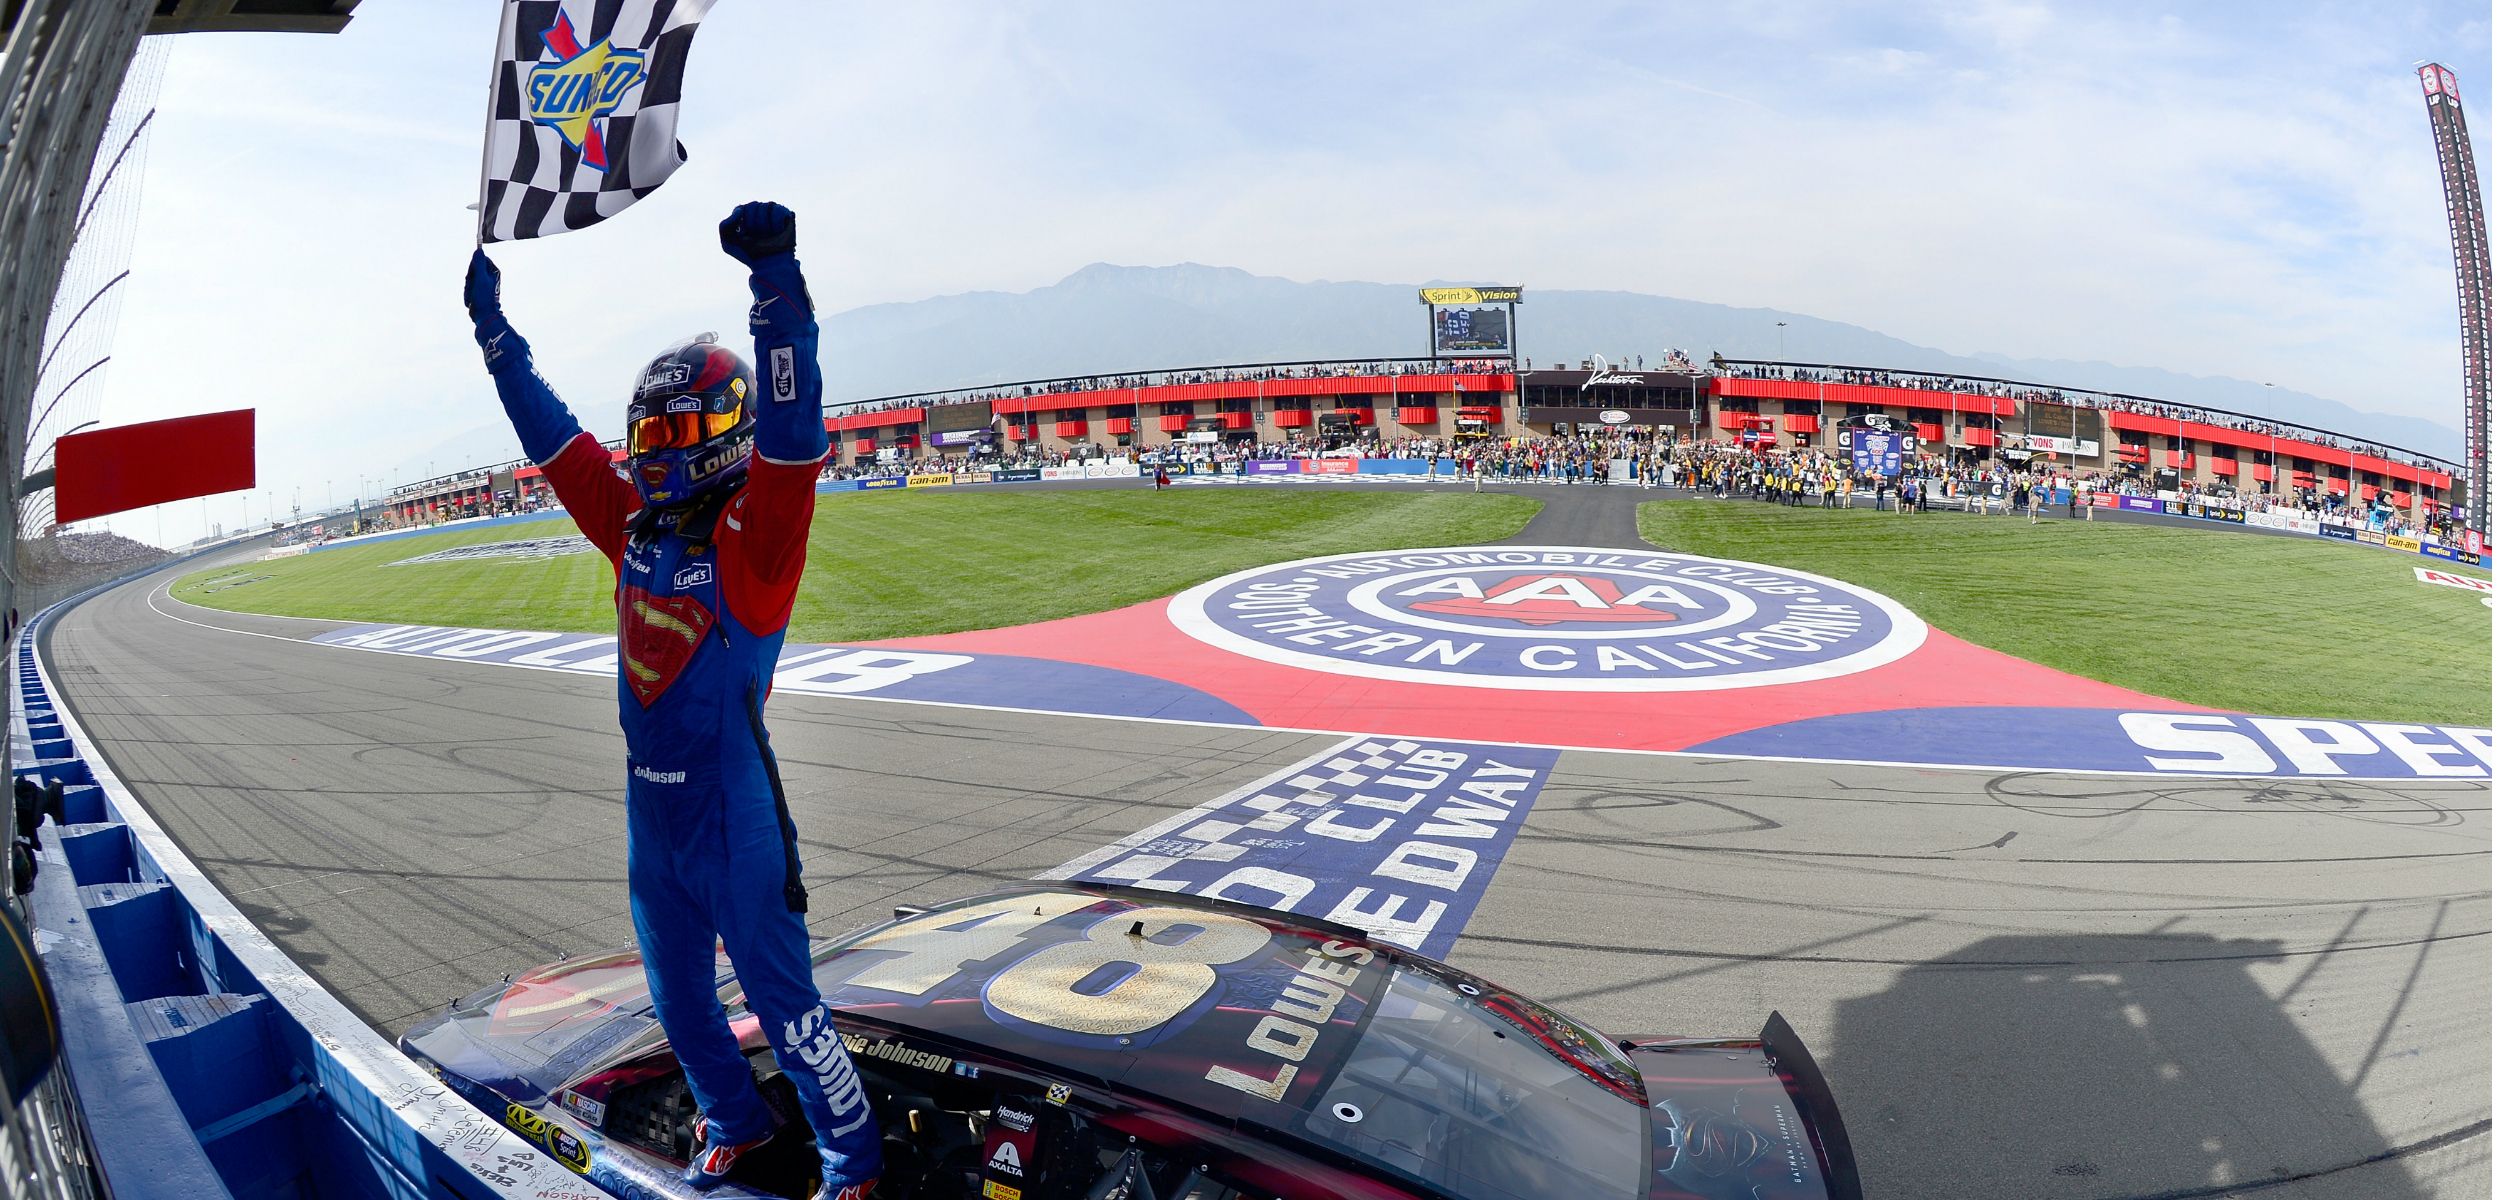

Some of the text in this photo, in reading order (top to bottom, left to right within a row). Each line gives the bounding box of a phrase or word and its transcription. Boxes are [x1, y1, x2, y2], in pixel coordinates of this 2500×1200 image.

[530, 53, 643, 113] SUNCO
[1432, 291, 1517, 301] Sprint Vision
[671, 401, 697, 409] LOWE'S
[2033, 437, 2054, 448] VONS
[866, 479, 898, 488] GOODYEAR
[909, 475, 949, 485] can-am
[2388, 538, 2418, 550] can-am
[1302, 551, 1819, 595] AUTOMOBILE CLUB
[1395, 576, 1705, 609] AAA
[1228, 582, 1863, 673] SOUTHERN CALIFORNIA
[325, 625, 562, 657] AUTO
[634, 766, 686, 783] Johnson
[1304, 748, 1469, 842] CLUB
[1323, 759, 1537, 951] EDWAY
[845, 893, 1273, 1035] 48
[1204, 940, 1375, 1103] LOWE'S
[867, 1040, 952, 1073] Johnson
[784, 1005, 871, 1138] LOWE'S
[562, 1103, 599, 1123] RACE CAR
[576, 1096, 598, 1114] NASCAR
[997, 1105, 1035, 1124] Hendrick
[559, 1142, 577, 1157] Sprint
[988, 1160, 1023, 1177] AXALTA
[995, 1185, 1019, 1197] BOSCH
